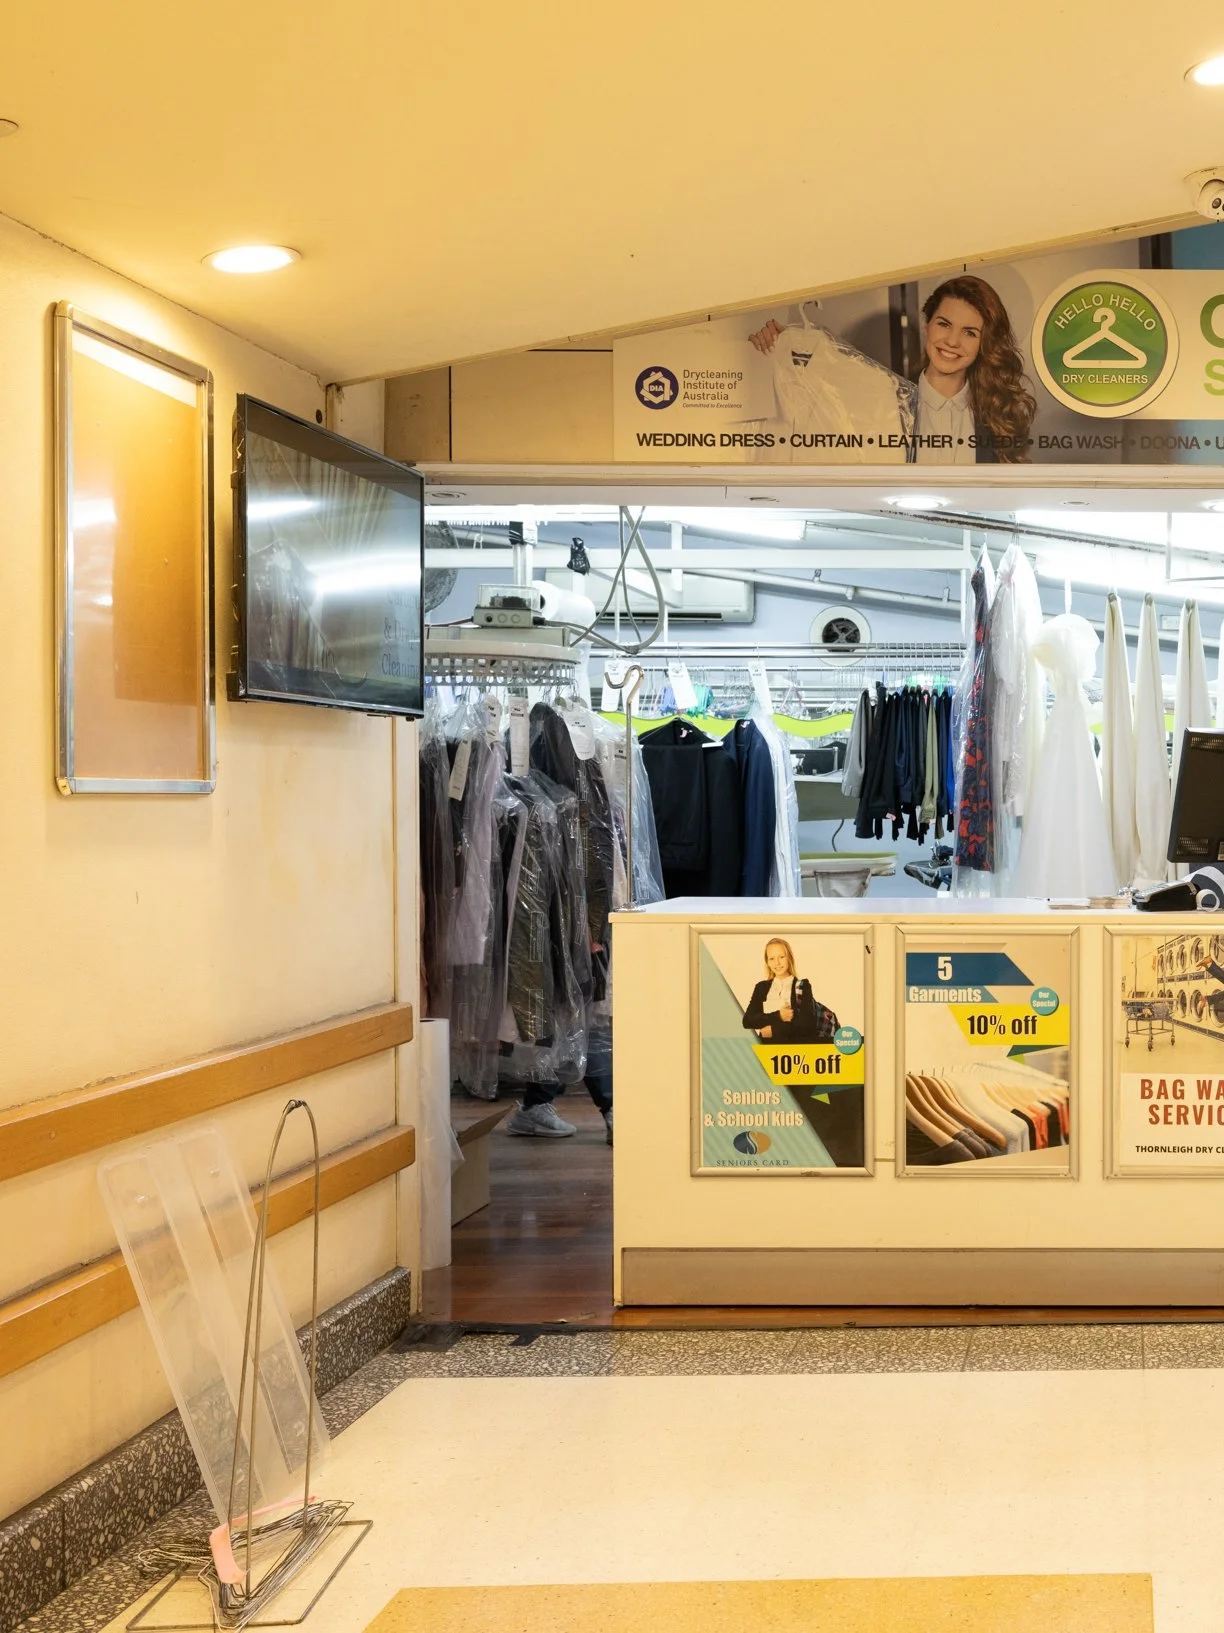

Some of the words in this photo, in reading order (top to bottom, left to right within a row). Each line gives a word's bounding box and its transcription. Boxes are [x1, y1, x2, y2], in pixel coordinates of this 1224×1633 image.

[1055, 294, 1103, 329] HELLO
[1109, 294, 1156, 330] HELLO
[683, 369, 743, 381] Drycleaning
[1062, 374, 1085, 384] DRY
[1088, 374, 1148, 384] CLEANERS
[683, 381, 725, 390] Institute
[727, 381, 738, 390] of
[682, 392, 729, 401] Australia
[636, 432, 717, 448] WEDDING
[720, 433, 776, 448] DRESS
[789, 433, 863, 448] CURTAIN
[878, 433, 953, 449] LEATHER
[968, 434, 1025, 449] SUEDE
[1038, 434, 1073, 450] BAG
[1075, 434, 1125, 450] WASH
[1140, 435, 1201, 450] DOONA
[937, 956, 953, 981] 5
[908, 986, 982, 1003] Garments
[1038, 991, 1050, 999] Our
[1032, 999, 1056, 1008] Special
[967, 1014, 1006, 1036] 10%
[1011, 1014, 1038, 1036] off
[841, 1030, 853, 1038] Our
[836, 1039, 860, 1048] Special
[770, 1054, 810, 1076] 10%
[815, 1054, 841, 1074] off
[1140, 1078, 1185, 1100] BAG
[722, 1089, 781, 1106] Seniors
[704, 1112, 715, 1127] &
[717, 1111, 769, 1127] School
[771, 1111, 804, 1127] kids
[1135, 1145, 1193, 1154] THORNLEIGH
[1195, 1146, 1214, 1154] DRY
[716, 1159, 759, 1167] SENIORS
[761, 1159, 789, 1167] CARD
